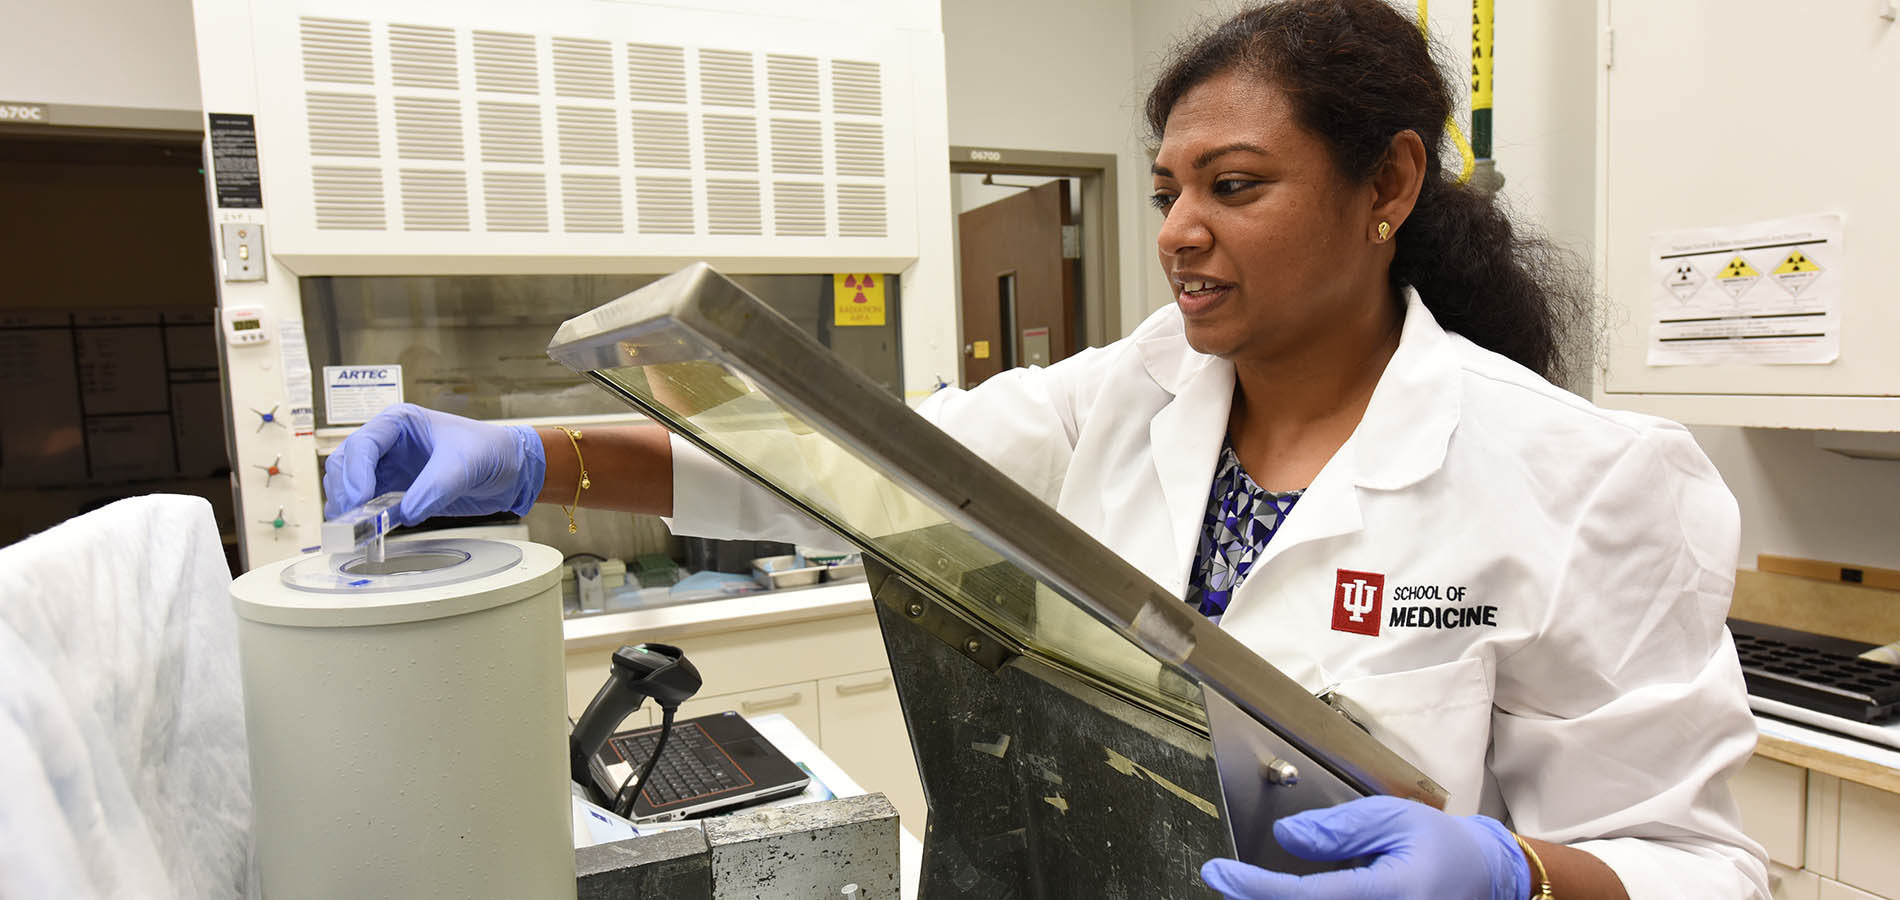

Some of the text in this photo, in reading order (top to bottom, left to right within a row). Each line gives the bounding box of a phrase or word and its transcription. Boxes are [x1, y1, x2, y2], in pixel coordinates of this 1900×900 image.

[337, 369, 388, 379] ARTEC
[1393, 586, 1467, 601] SCHOOL OF
[1389, 606, 1498, 629] MEDICINE
